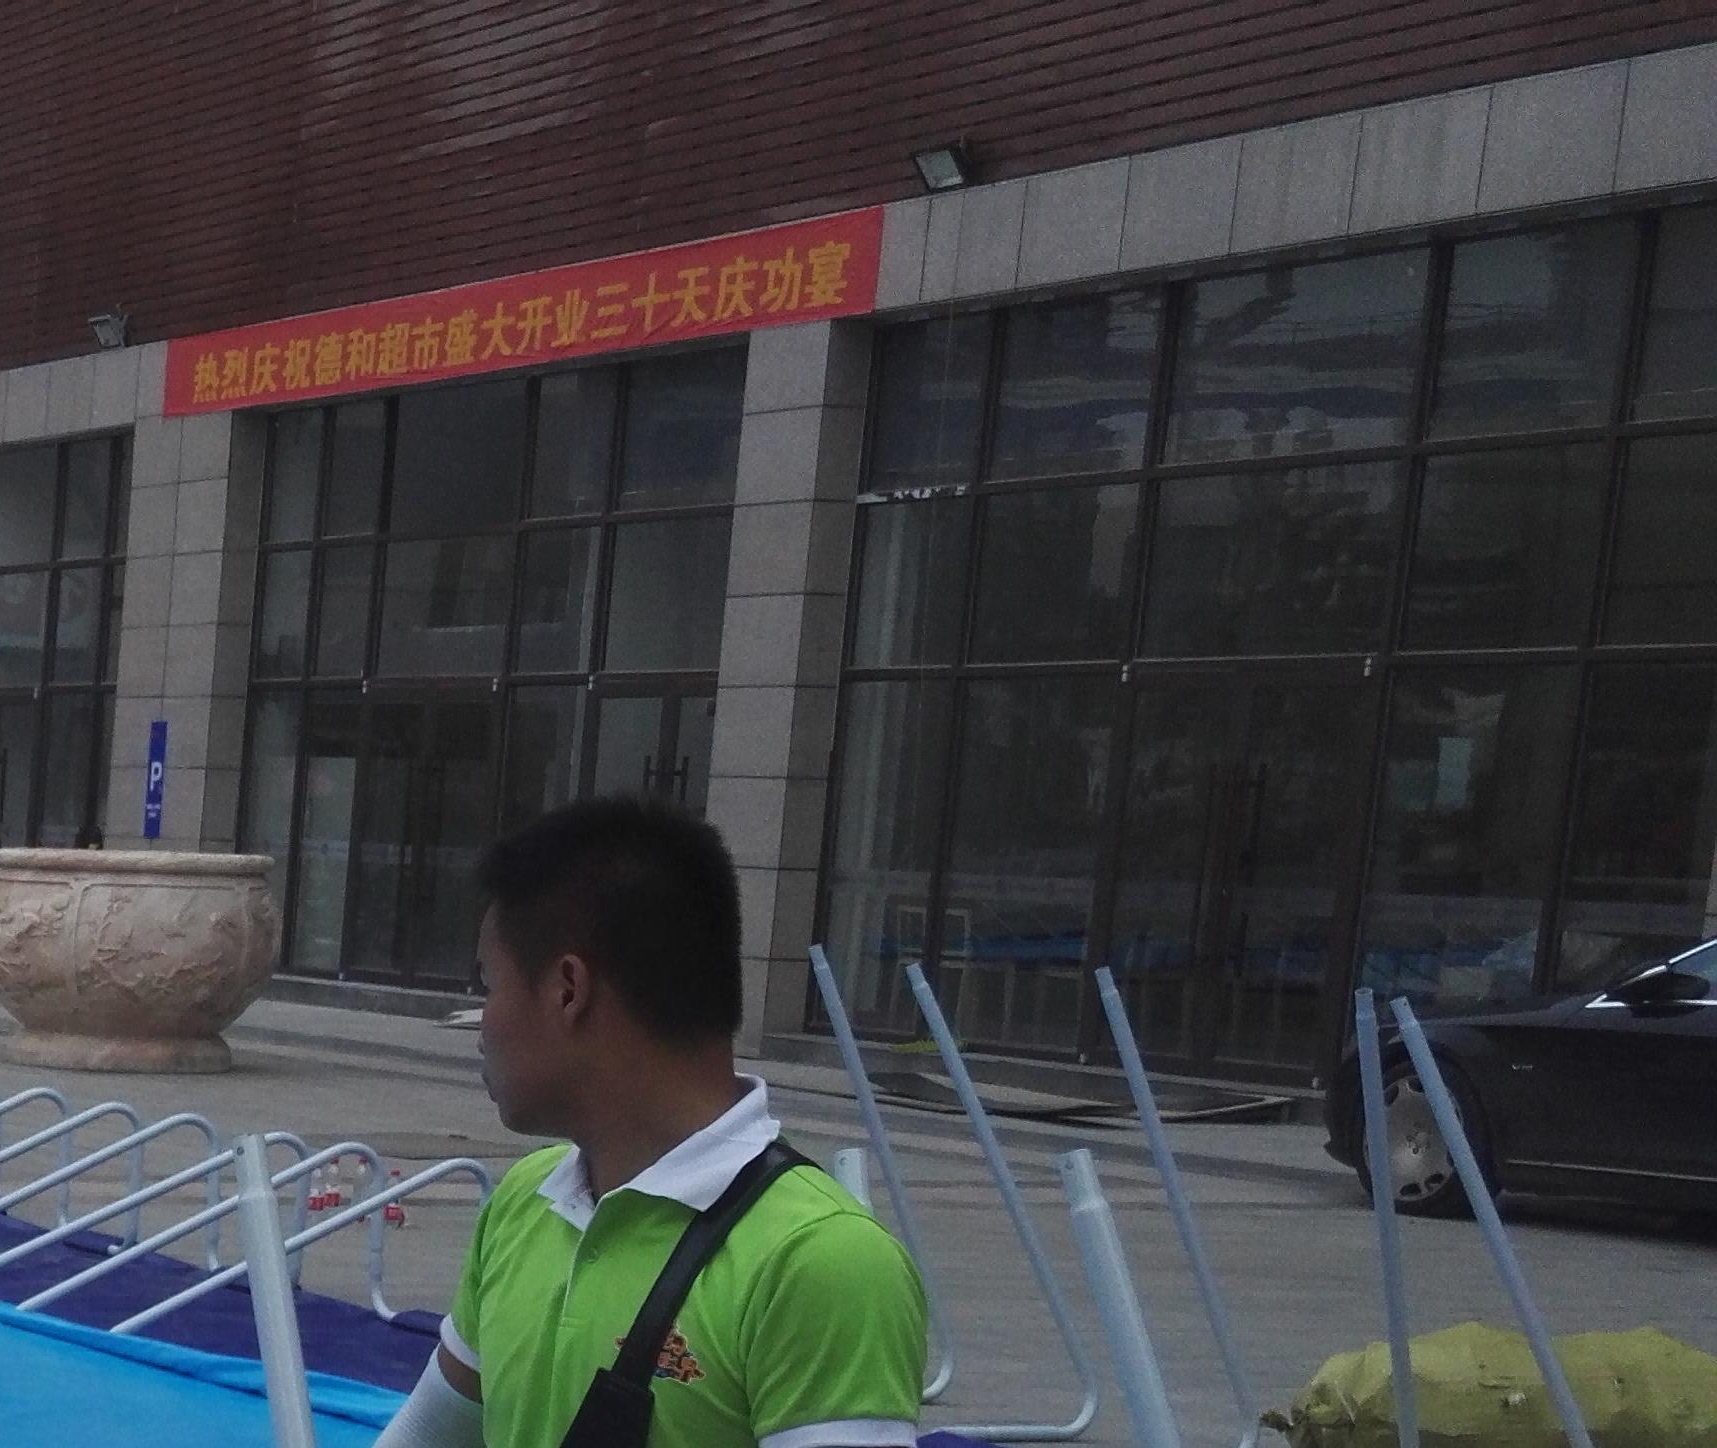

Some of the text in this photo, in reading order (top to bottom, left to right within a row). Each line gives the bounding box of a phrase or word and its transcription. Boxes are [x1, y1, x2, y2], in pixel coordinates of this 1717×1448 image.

[192, 241, 851, 404] 热烈庆祝德和超市盛大开业三十天庆功宴
[150, 761, 163, 791] P
